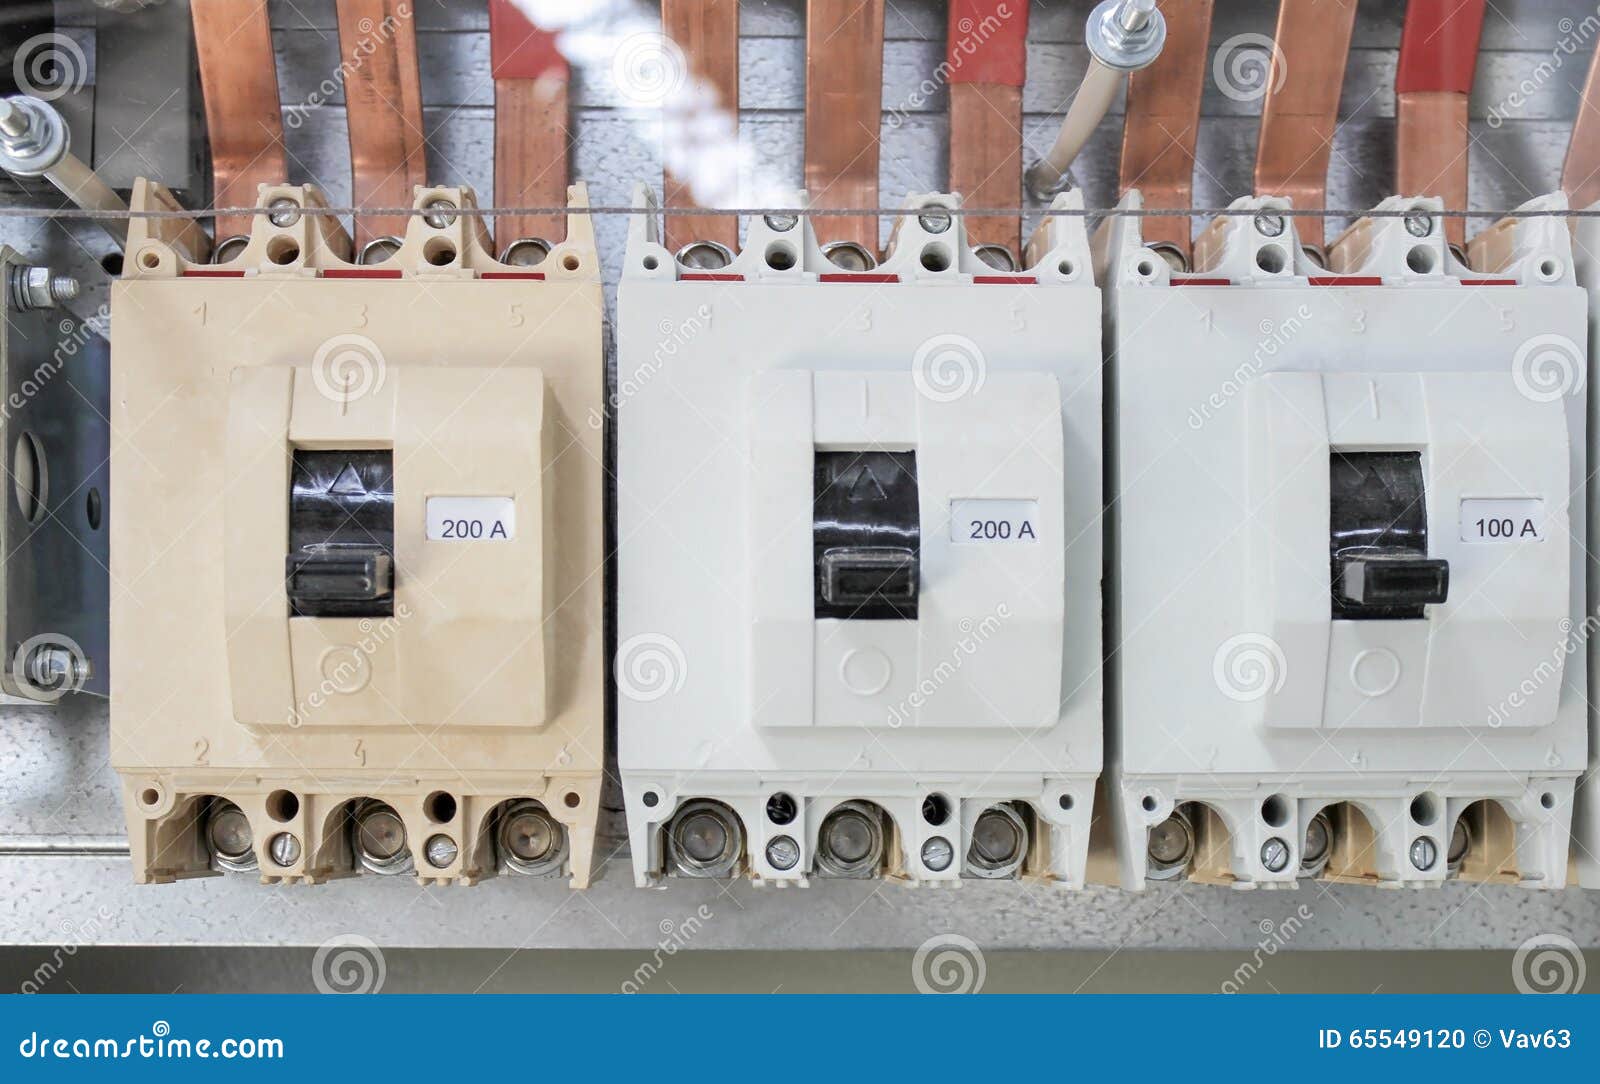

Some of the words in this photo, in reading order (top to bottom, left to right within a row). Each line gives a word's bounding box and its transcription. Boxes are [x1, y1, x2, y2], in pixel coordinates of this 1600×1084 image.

[442, 519, 483, 539] 200
[489, 520, 508, 539] A
[970, 520, 1011, 540] 200
[1017, 520, 1036, 539] A
[1476, 518, 1514, 538] 100
[1519, 518, 1538, 537] A
